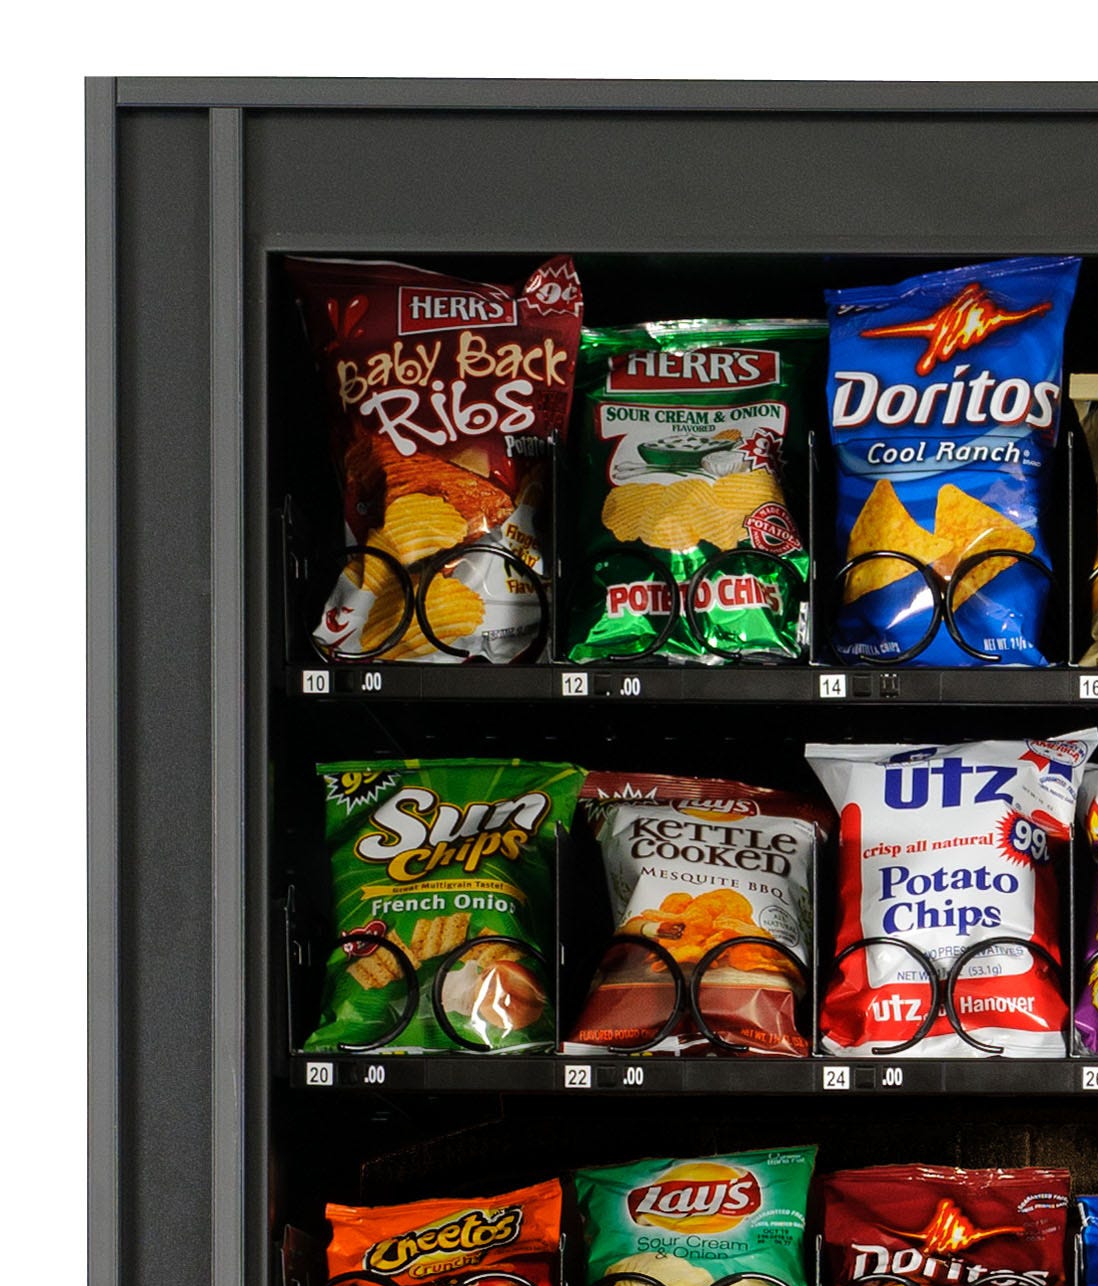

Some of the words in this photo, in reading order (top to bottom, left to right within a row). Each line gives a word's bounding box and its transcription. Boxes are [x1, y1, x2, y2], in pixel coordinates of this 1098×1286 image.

[410, 296, 504, 321] HERR'S
[338, 340, 441, 406] Baby
[457, 331, 568, 387] Back
[627, 351, 762, 384] HERR'S
[832, 364, 1060, 429] Doritos
[361, 379, 535, 457] Ribs
[606, 406, 650, 422] SOUR
[655, 409, 709, 424] CREAM
[714, 412, 725, 423] &
[730, 404, 780, 420] ONION
[672, 424, 716, 433] FLAVORED
[867, 442, 926, 464] Cool
[936, 442, 1020, 464] Ranch
[307, 676, 325, 692] 10
[361, 673, 382, 691] .00
[564, 677, 583, 694] 12
[822, 680, 841, 695] 14
[354, 787, 549, 862] Sun
[386, 829, 530, 882] Chips
[863, 842, 902, 859] crisp
[906, 839, 927, 853] all
[932, 833, 994, 850] natural
[641, 867, 740, 889] MESQUITE
[748, 881, 790, 905] BBQ
[878, 864, 1019, 901] Potato
[371, 894, 446, 915] French
[882, 899, 1001, 936] Chips
[897, 971, 917, 982] NET
[967, 964, 1003, 977] (53.1g)
[960, 996, 1036, 1014] Hanover
[309, 1066, 328, 1082] 20
[364, 1065, 385, 1084] .00
[568, 1069, 587, 1085] 22
[826, 1071, 846, 1086] 24
[882, 1068, 903, 1086] .00
[366, 1211, 515, 1271] Cheetos
[637, 1236, 680, 1252] Sour
[686, 1235, 749, 1251] Cream
[655, 1247, 667, 1259] &
[673, 1246, 729, 1260] Onion
